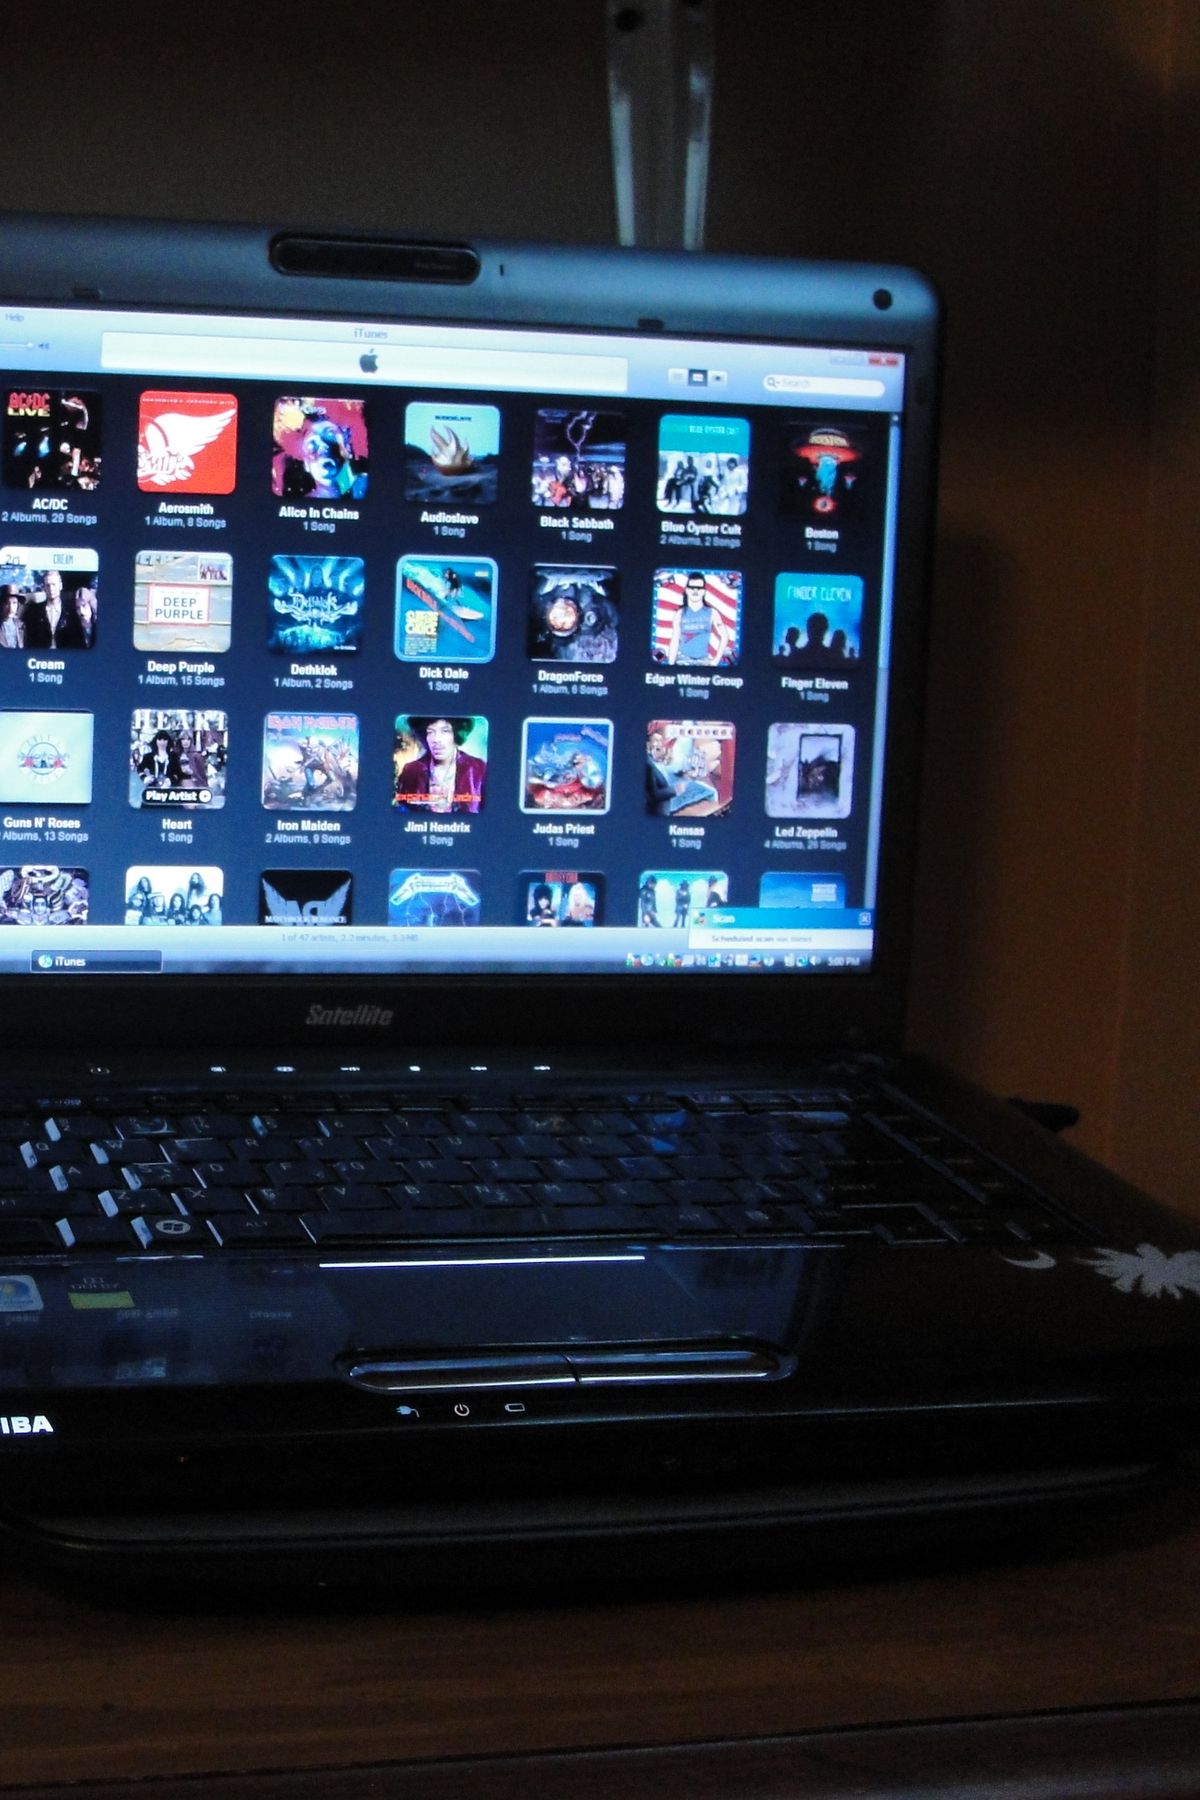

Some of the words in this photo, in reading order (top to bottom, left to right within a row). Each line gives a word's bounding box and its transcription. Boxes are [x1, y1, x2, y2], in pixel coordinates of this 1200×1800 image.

[5, 312, 25, 323] Help
[354, 328, 388, 340] iTunes
[8, 408, 50, 417] LIVE
[32, 499, 68, 510] AC/DC
[159, 502, 214, 515] Aerosmith
[11, 512, 49, 524] Albums,
[67, 513, 97, 525] Songs
[279, 506, 307, 518] Alice
[322, 508, 359, 520] Chains
[421, 511, 479, 524] Audioslave
[153, 517, 186, 528] Album,
[196, 518, 226, 529] Songs
[311, 522, 336, 533] Song
[540, 516, 569, 527] Black
[572, 517, 614, 530] Sabbath
[661, 521, 685, 532] Blue
[721, 523, 741, 535] Cult
[805, 527, 839, 539] Boston
[163, 597, 197, 607] DEEP
[155, 609, 204, 620] PURPLE
[28, 658, 65, 670] Cream
[148, 660, 176, 673] Deep
[178, 661, 215, 674] Purple
[291, 664, 337, 676] Dethklok
[37, 673, 63, 684] Song
[419, 667, 443, 679] Dick
[445, 668, 469, 680] Dale
[538, 670, 604, 684] DragonForce
[145, 675, 179, 687] Album,
[194, 676, 225, 688] Songs
[645, 673, 675, 686] Edgar
[677, 674, 710, 686] Winter
[712, 675, 743, 688] Group
[781, 677, 812, 690] Finger
[815, 678, 849, 690] Eleven
[435, 681, 459, 693] Song
[146, 792, 168, 803] Play
[169, 792, 197, 801] Artist
[3, 817, 32, 828] Guns
[34, 818, 46, 828] N'
[49, 818, 80, 828] Roses
[162, 819, 193, 830] Heart
[277, 820, 299, 831] Iron
[301, 820, 341, 832] Maiden
[404, 822, 427, 833] Jimi
[430, 822, 471, 833] Hendrix
[533, 824, 563, 835] Judas
[566, 824, 595, 835] Priest
[669, 825, 704, 836] Kansas
[775, 826, 794, 838] Led
[796, 827, 838, 840] Zeppelin
[2, 831, 42, 842] Albums,
[58, 832, 89, 843] Songs
[168, 833, 193, 844] Song
[55, 957, 86, 968] iTunes
[306, 1004, 394, 1025] Satellite
